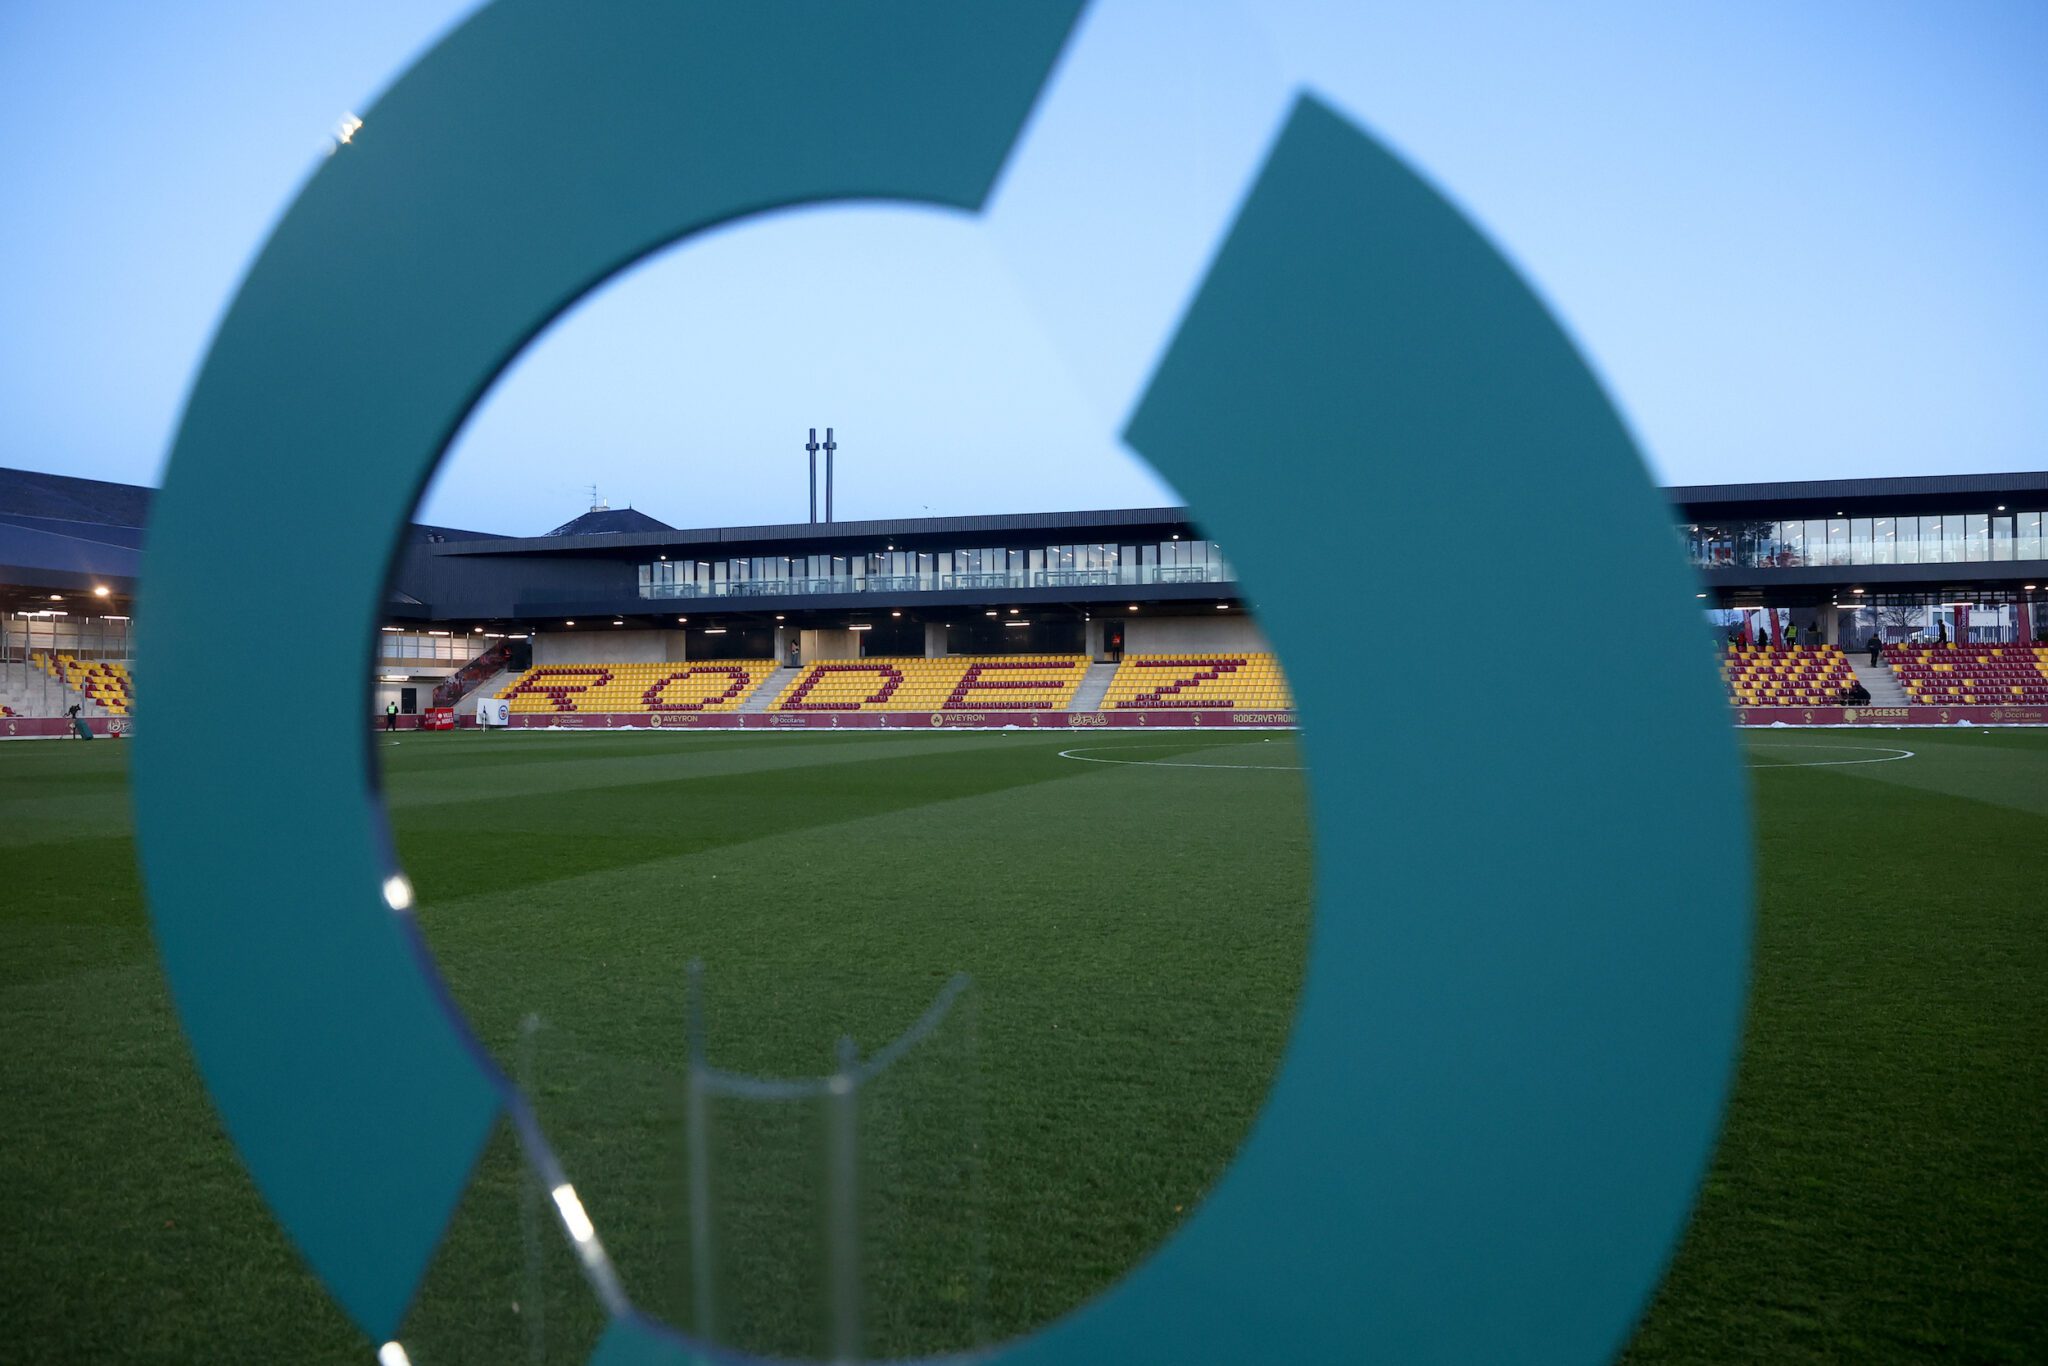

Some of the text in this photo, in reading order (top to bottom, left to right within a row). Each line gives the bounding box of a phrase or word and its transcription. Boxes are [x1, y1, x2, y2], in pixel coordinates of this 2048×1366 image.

[504, 659, 1247, 711] RODEZ
[1859, 708, 1909, 717] SAGESSE
[1233, 714, 1296, 723] RODEZAVEYRON
